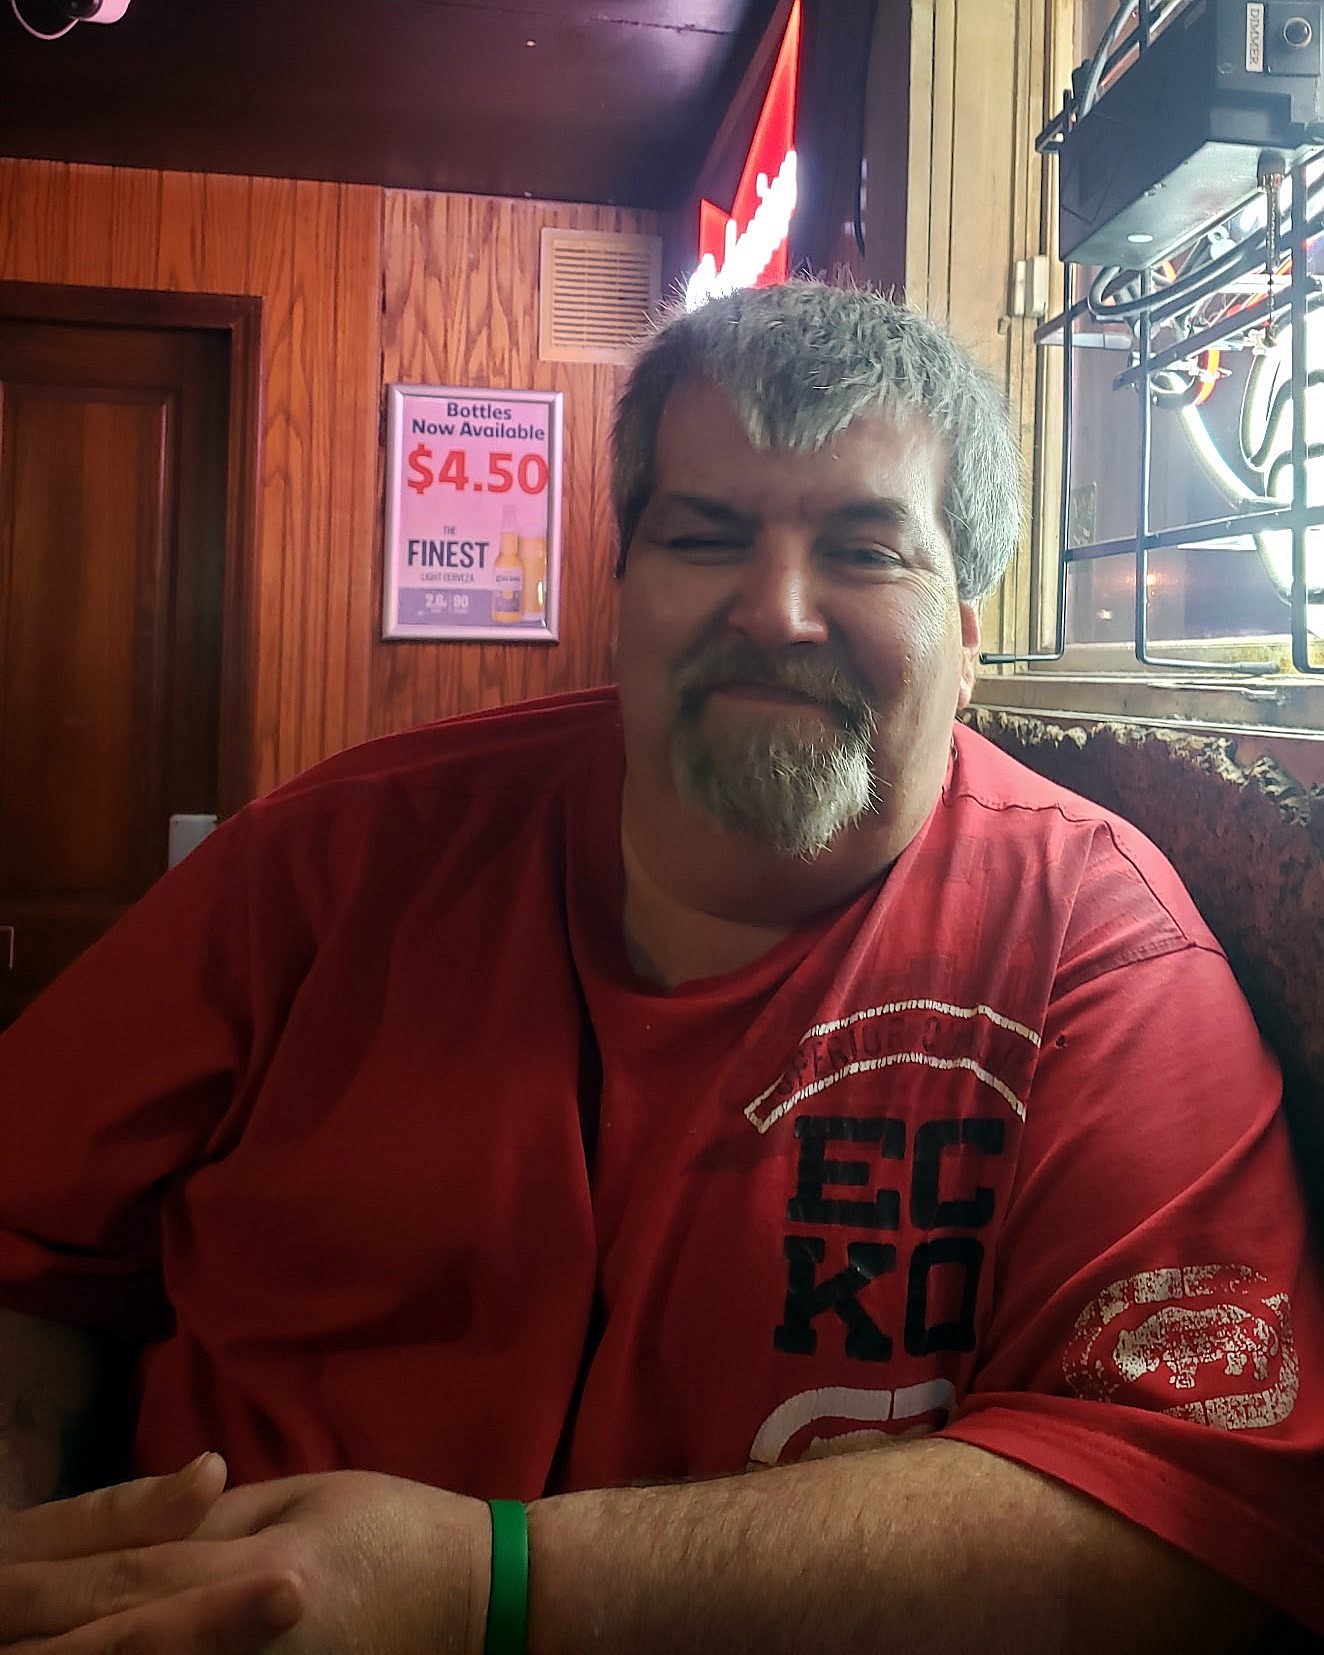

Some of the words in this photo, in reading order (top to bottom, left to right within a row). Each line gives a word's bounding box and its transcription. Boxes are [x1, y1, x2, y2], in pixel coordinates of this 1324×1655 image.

[1249, 8, 1260, 65] DIMMER
[447, 402, 512, 420] Bottles
[412, 419, 454, 436] Now
[460, 423, 545, 441] Available
[407, 444, 548, 495] $4.50
[407, 540, 490, 569] FINEST
